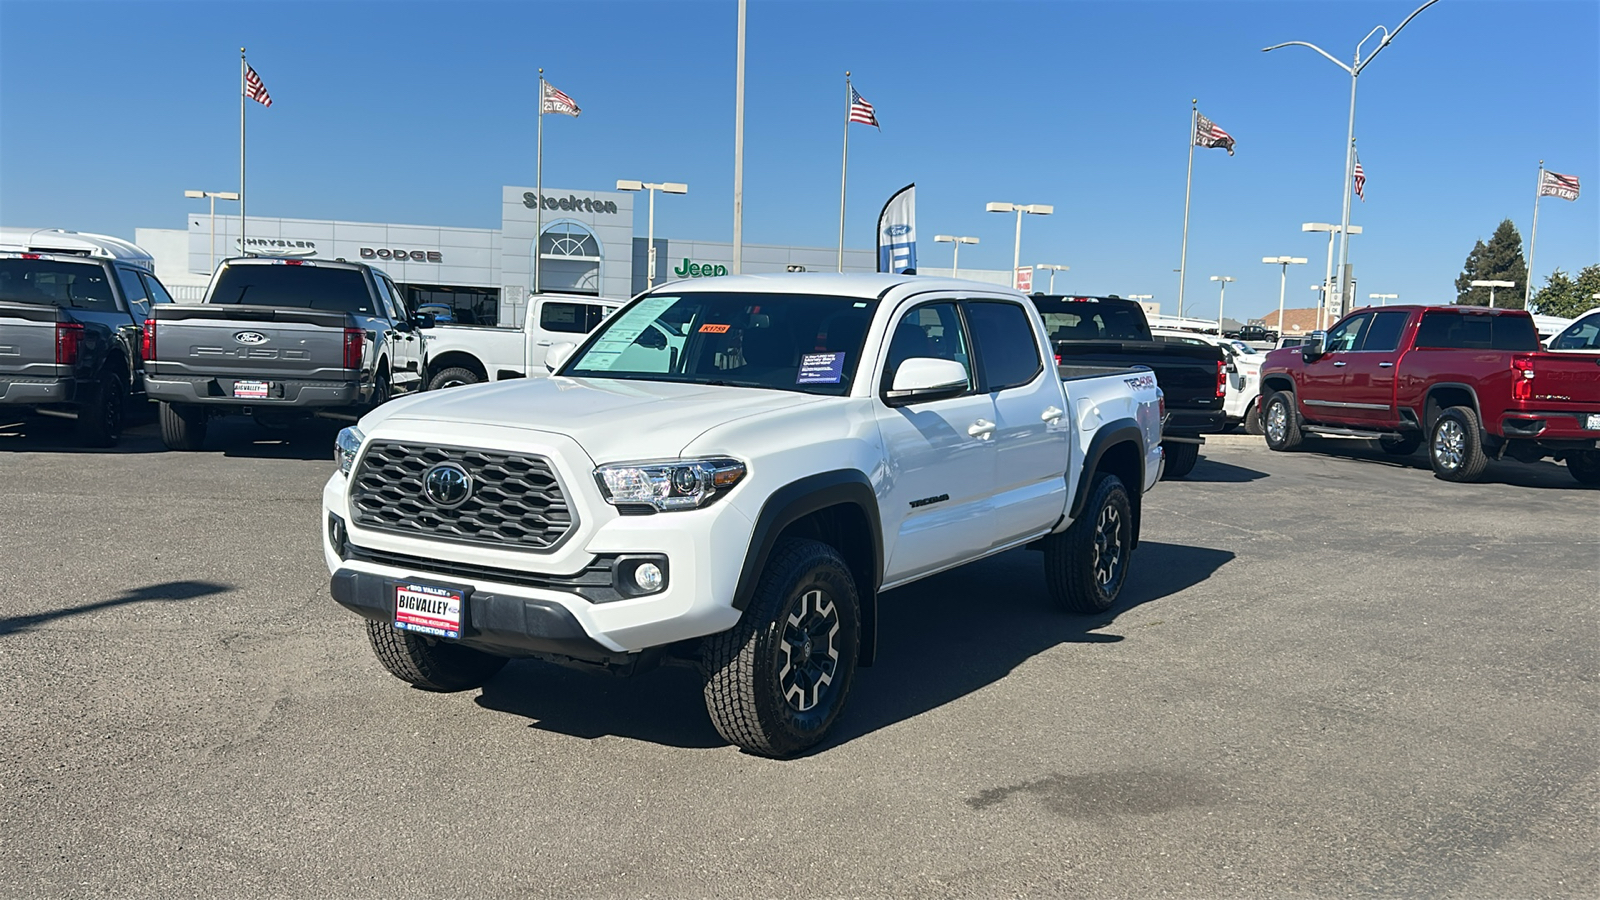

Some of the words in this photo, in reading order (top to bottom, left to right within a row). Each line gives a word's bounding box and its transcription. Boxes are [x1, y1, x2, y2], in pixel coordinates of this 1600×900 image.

[523, 192, 617, 214] Stockton
[237, 238, 316, 249] CHRYSLER
[360, 247, 443, 263] DODGE
[674, 258, 728, 278] Jeep
[190, 345, 311, 361] F-150
[424, 586, 446, 596] VALLEY
[399, 594, 449, 616] BIGVALLEY
[407, 624, 445, 636] STOCKTON
